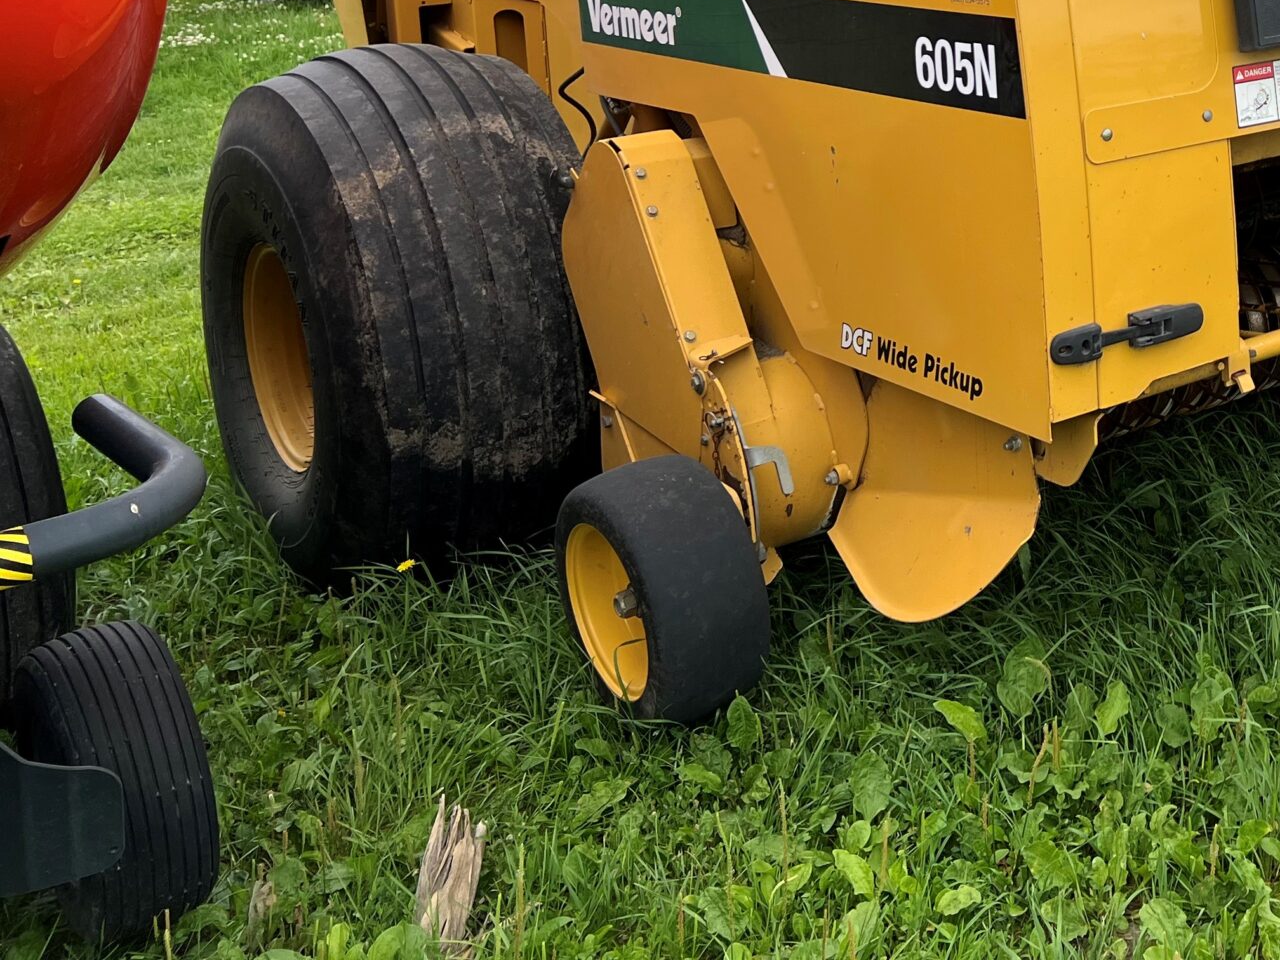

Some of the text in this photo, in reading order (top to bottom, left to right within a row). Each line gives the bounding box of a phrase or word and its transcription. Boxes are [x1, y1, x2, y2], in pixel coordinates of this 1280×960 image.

[914, 36, 998, 99] 605N
[1244, 66, 1272, 78] DANGER
[840, 322, 984, 400] DCF Wide Pickup
